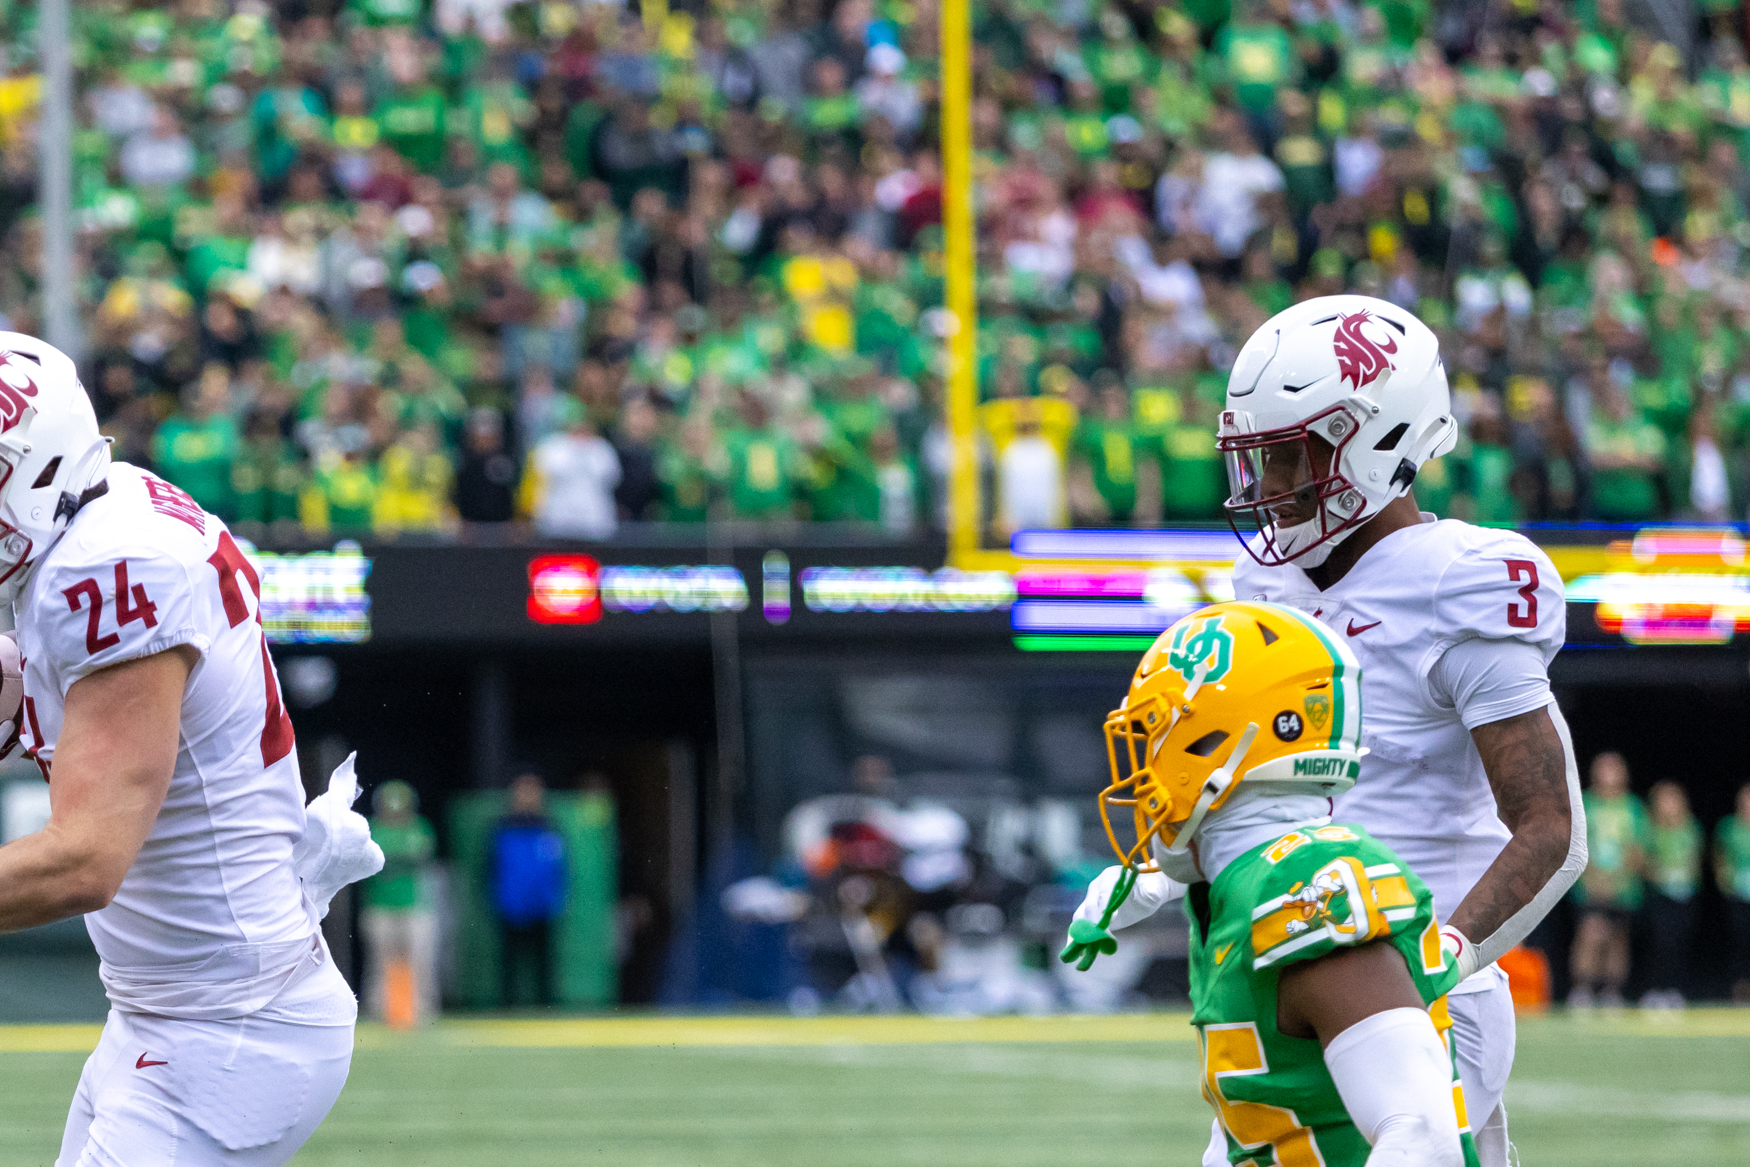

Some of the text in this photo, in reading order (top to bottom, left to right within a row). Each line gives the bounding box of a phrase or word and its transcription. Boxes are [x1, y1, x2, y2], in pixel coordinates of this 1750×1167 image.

[60, 558, 158, 655] 24
[1502, 559, 1539, 628] 3
[1277, 713, 1300, 734] 64
[1293, 757, 1348, 777] MIGHTY
[1259, 825, 1361, 866] 25
